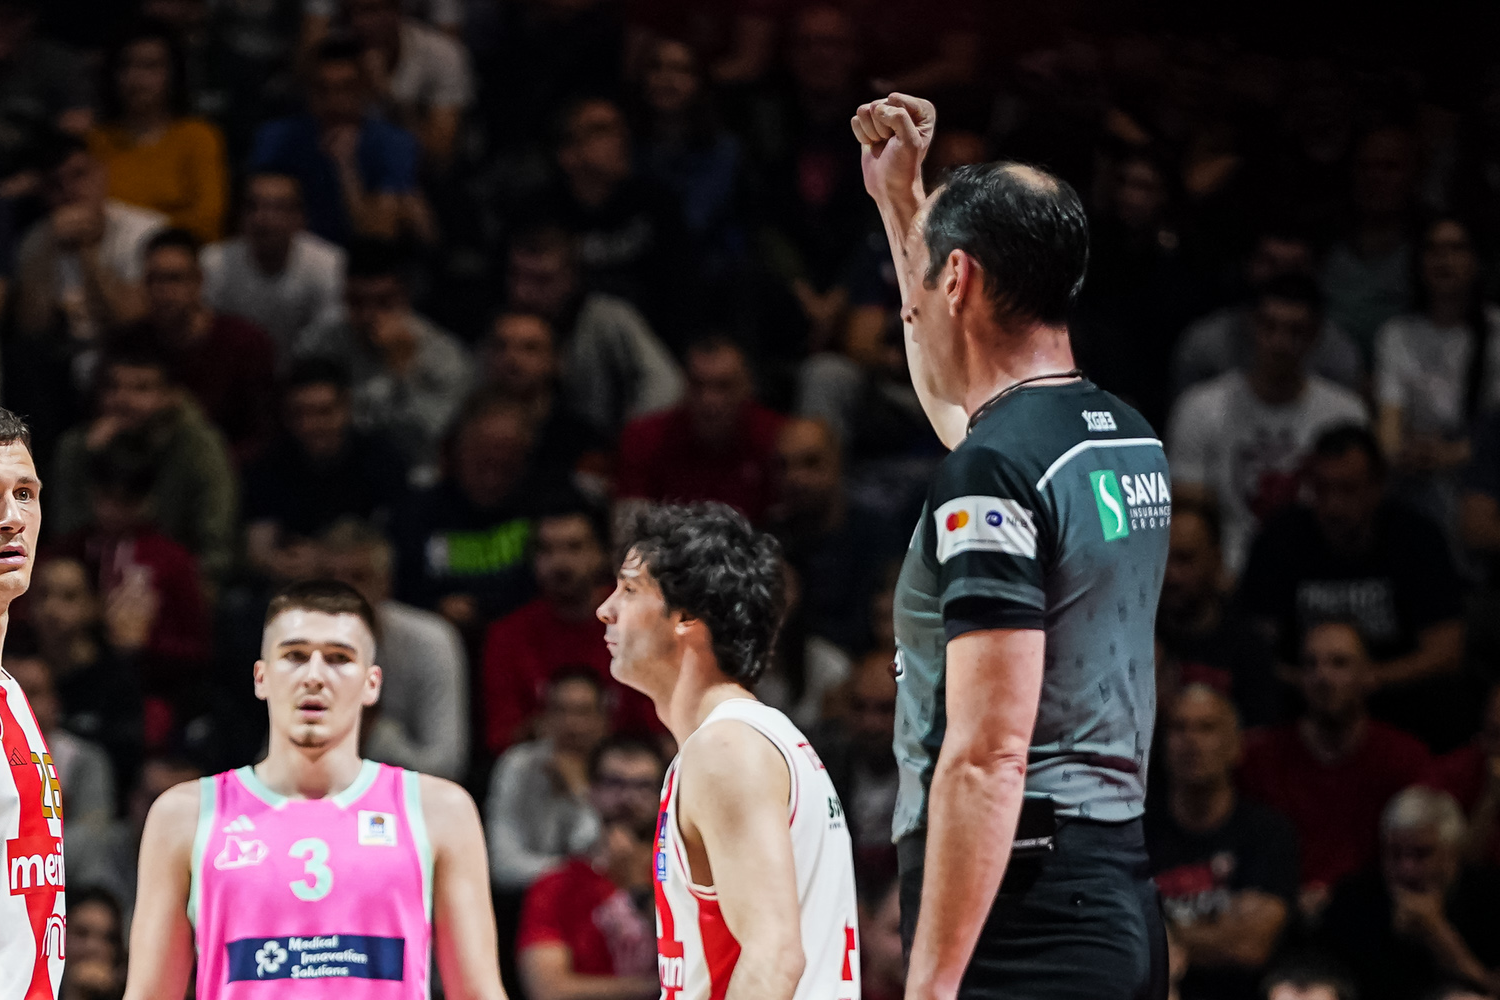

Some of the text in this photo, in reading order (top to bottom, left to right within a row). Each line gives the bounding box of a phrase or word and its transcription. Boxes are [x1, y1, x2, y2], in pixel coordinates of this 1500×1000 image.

[1121, 472, 1171, 507] SAVA
[288, 837, 334, 901] 3
[288, 935, 338, 951] Medical
[301, 949, 368, 965] Innovation
[290, 964, 349, 978] Solutions
